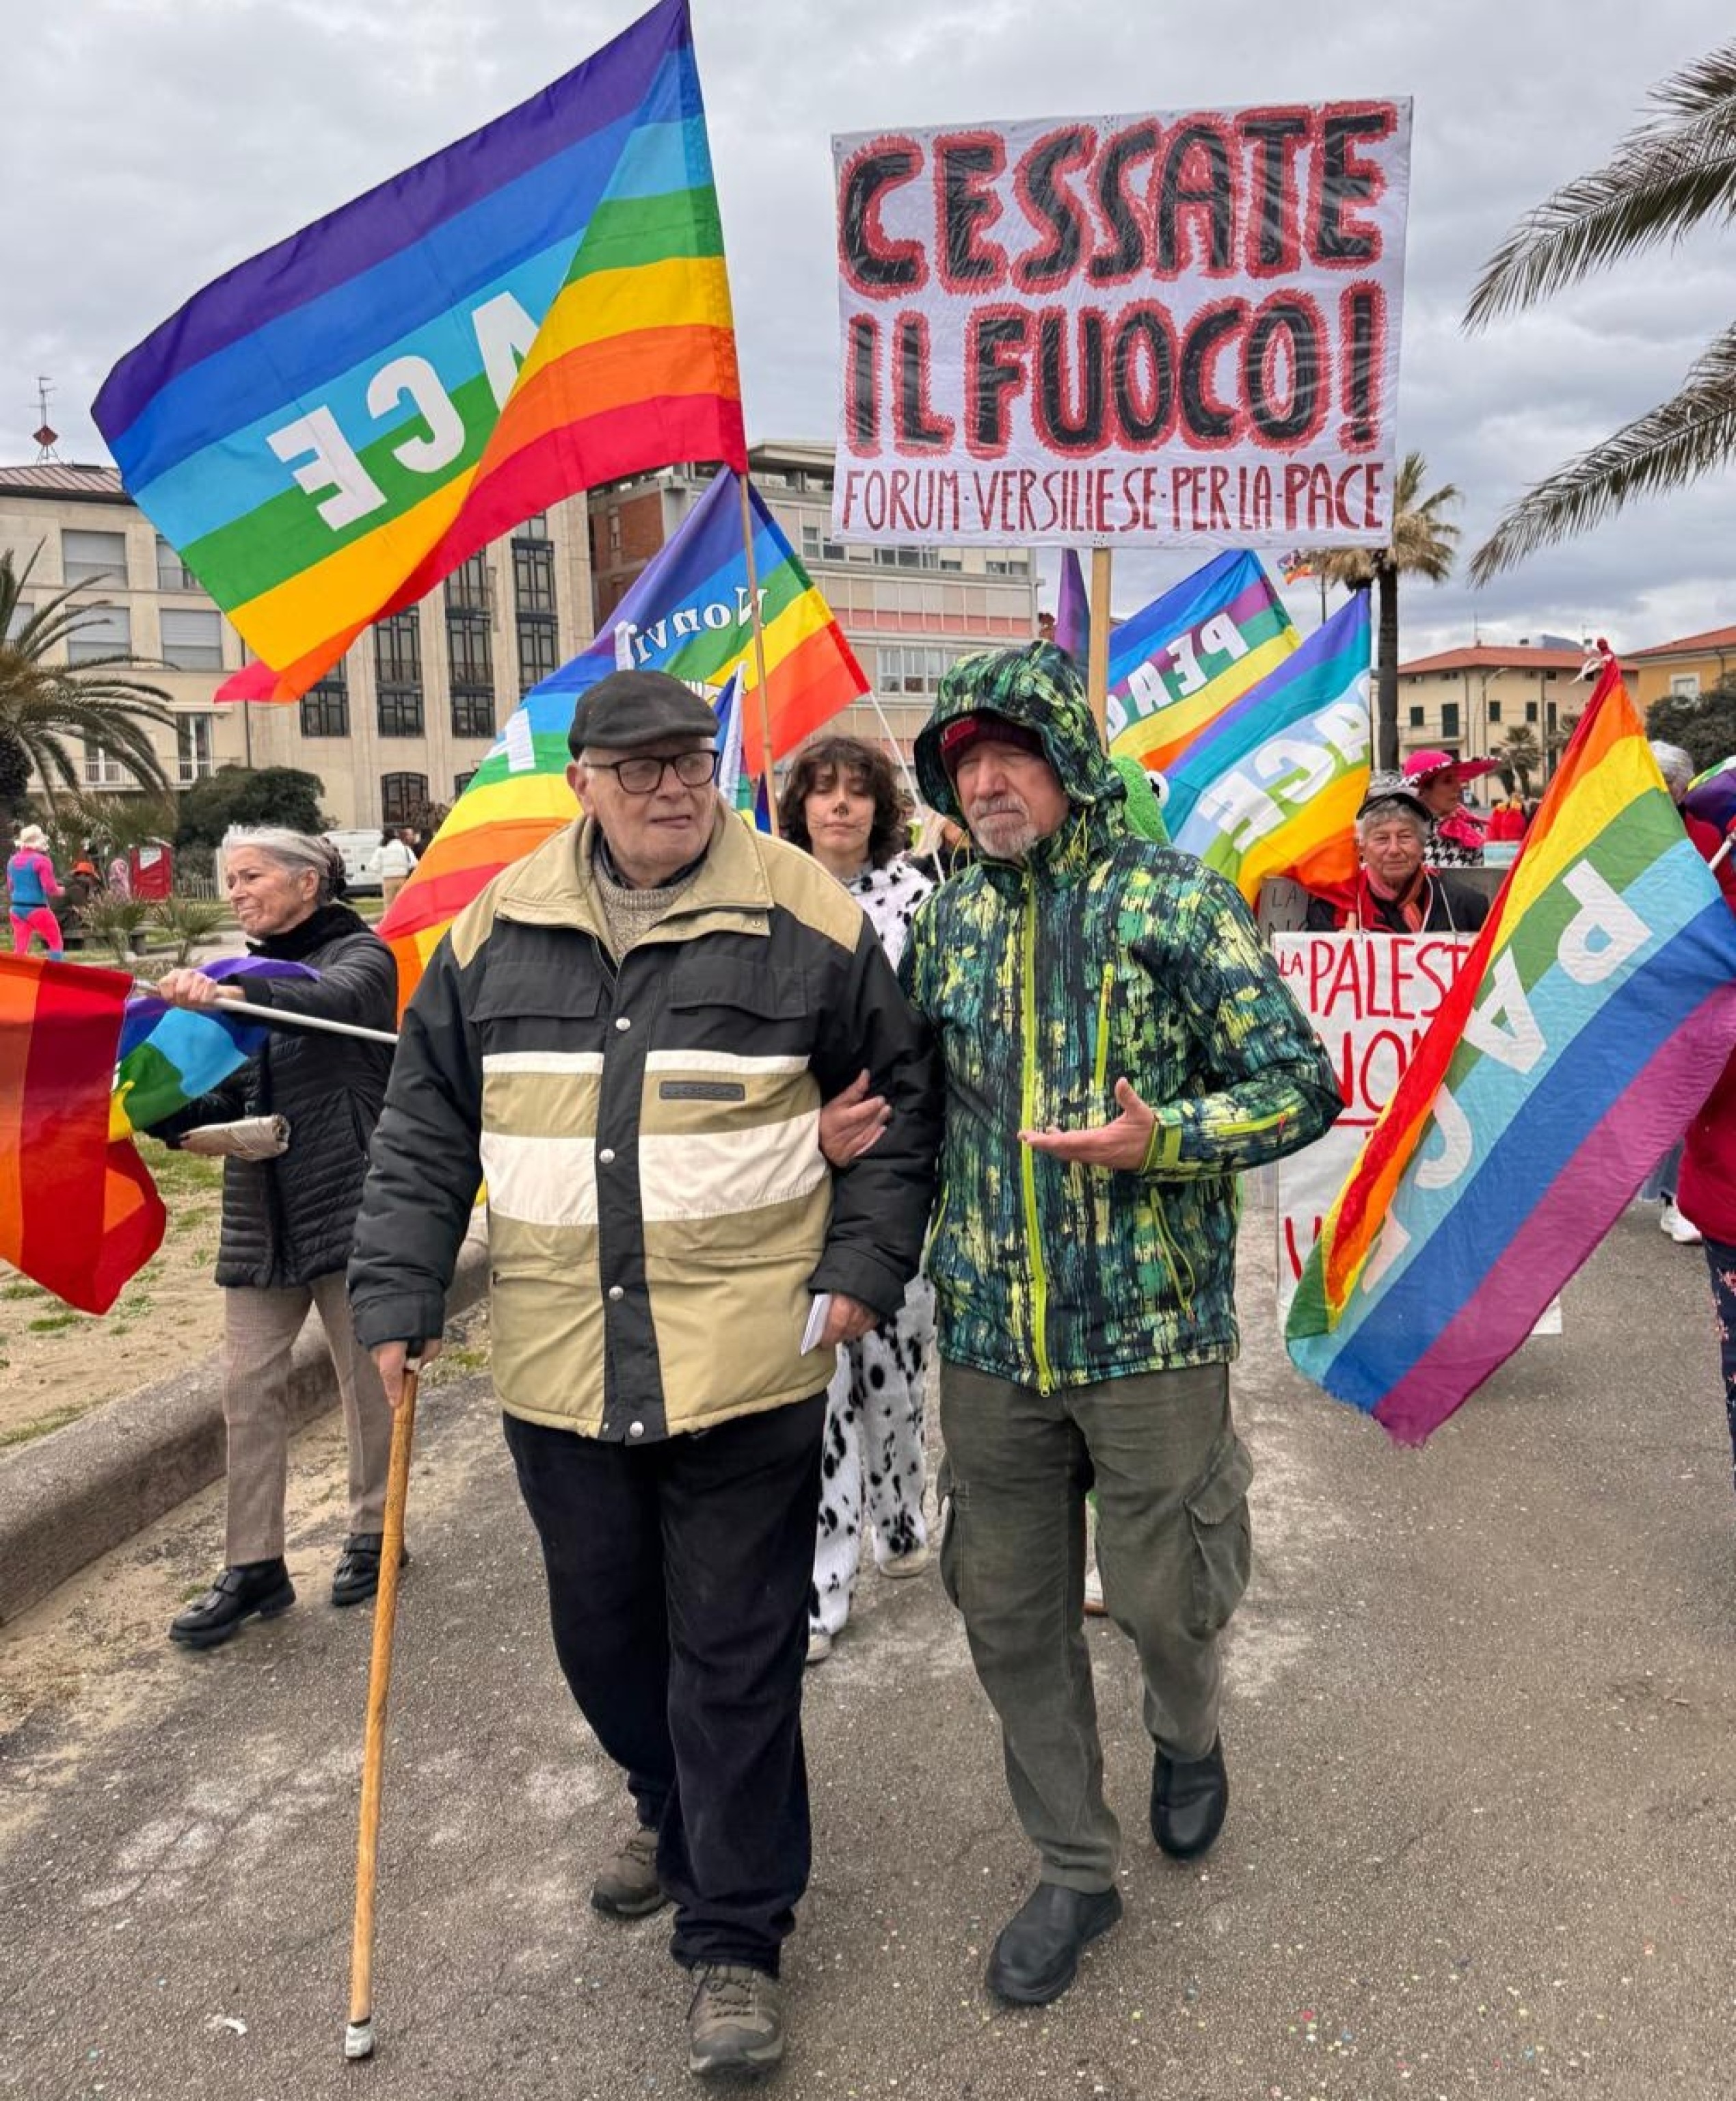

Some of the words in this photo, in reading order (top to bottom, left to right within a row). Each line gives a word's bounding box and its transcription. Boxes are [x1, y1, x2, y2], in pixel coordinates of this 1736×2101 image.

[838, 101, 1398, 299] CESSATE
[845, 310, 955, 458] IL
[965, 279, 1387, 461] FUOCO!
[842, 469, 959, 531] FORUM
[973, 466, 1158, 532] VERSILIESE
[1171, 465, 1231, 531] PER
[1239, 464, 1272, 531] LA
[1284, 462, 1384, 531] PACE
[1279, 949, 1304, 977] LA
[1309, 938, 1471, 1020] PALEST
